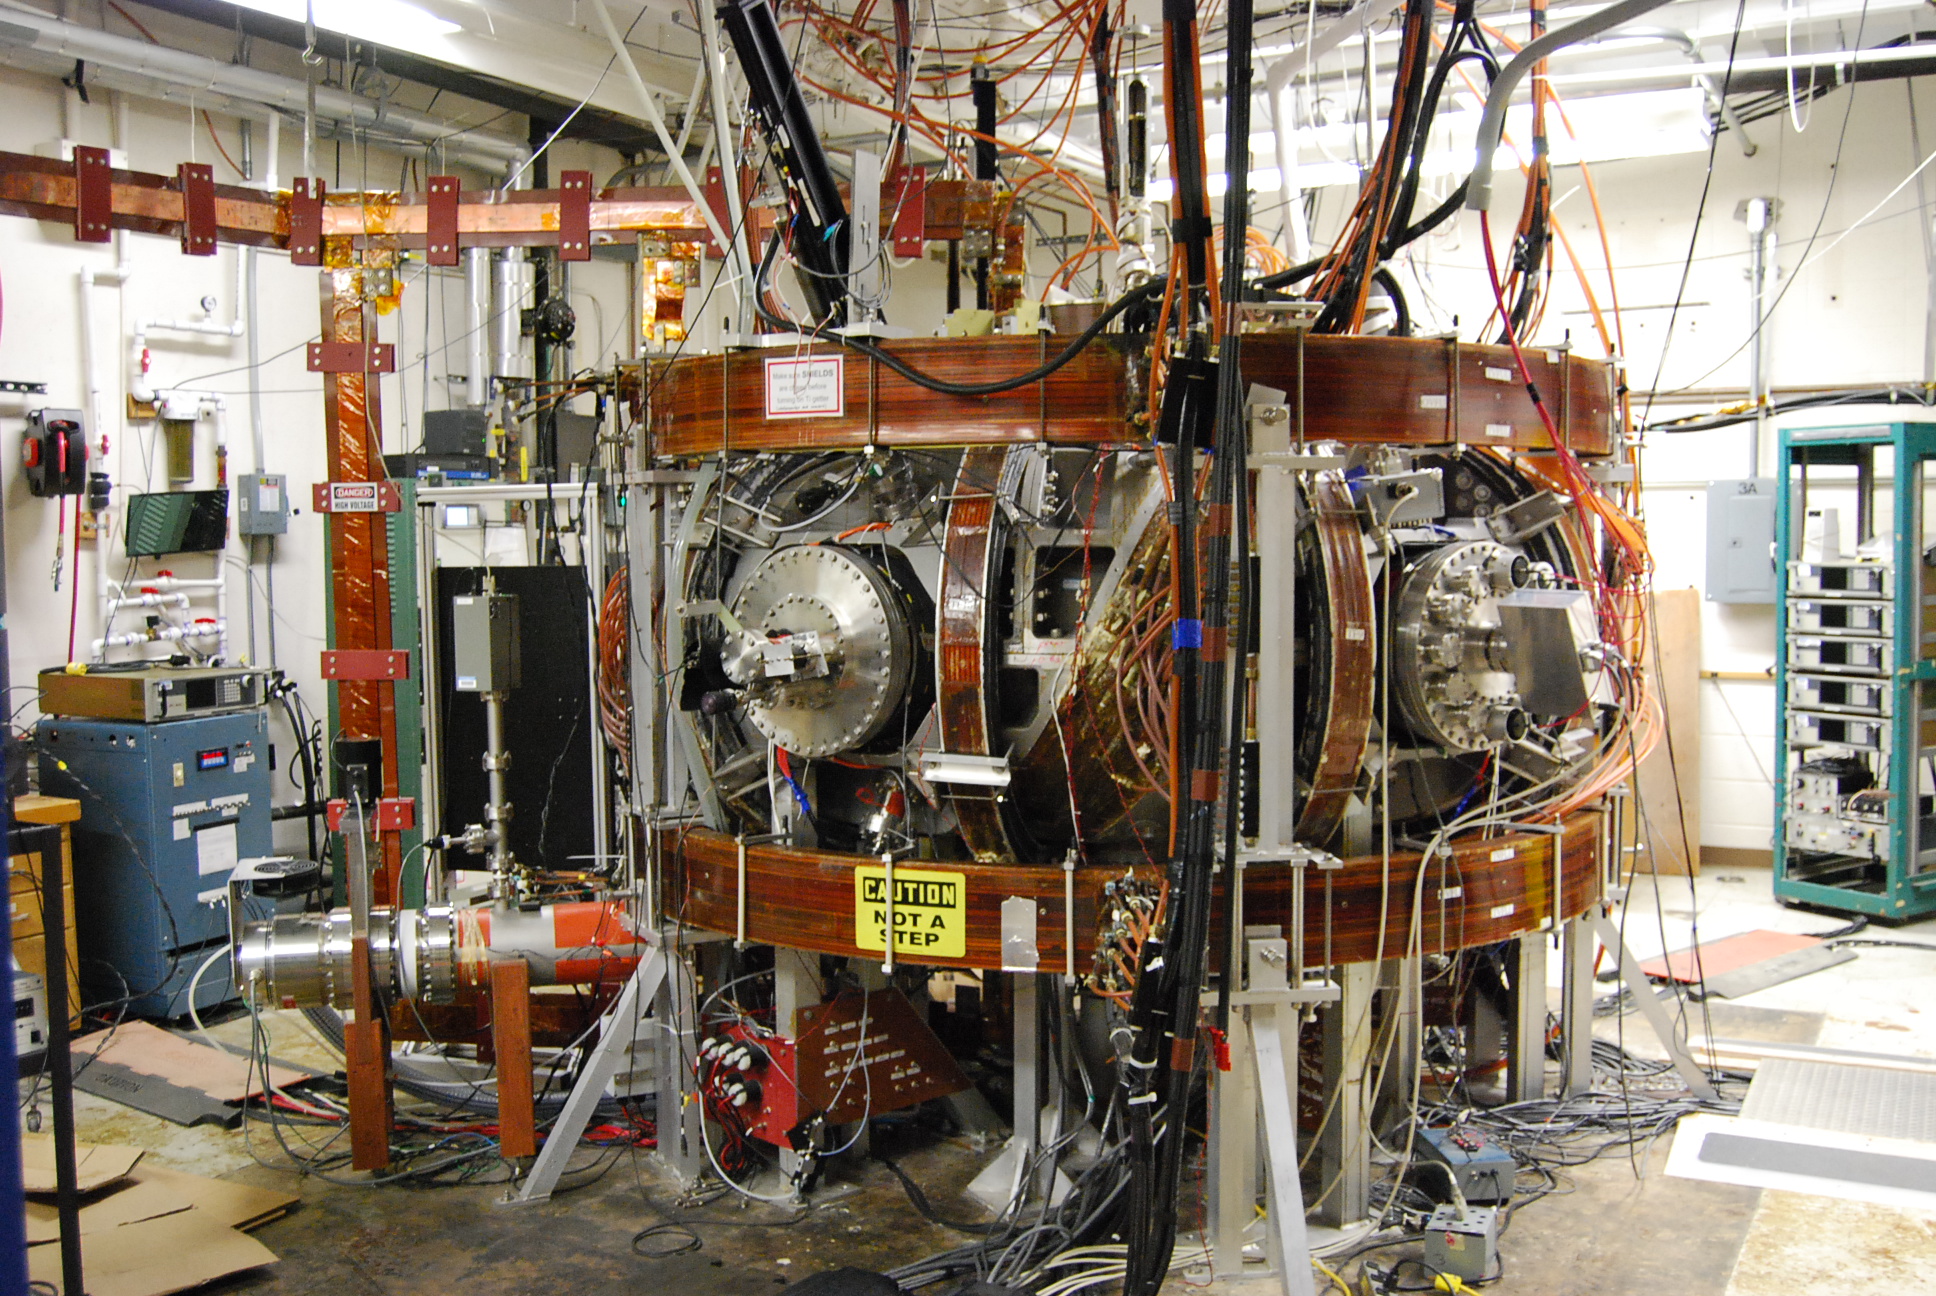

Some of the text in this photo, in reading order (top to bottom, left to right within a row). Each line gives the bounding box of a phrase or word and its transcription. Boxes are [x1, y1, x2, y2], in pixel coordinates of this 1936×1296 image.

[802, 369, 834, 378] SHIELDS
[338, 487, 370, 498] DANGER
[1738, 482, 1758, 495] 3A
[334, 501, 374, 510] HIGH VOLTAGE
[864, 879, 955, 906] CAUTION
[874, 910, 946, 929] NOT A
[880, 929, 939, 946] STEP
